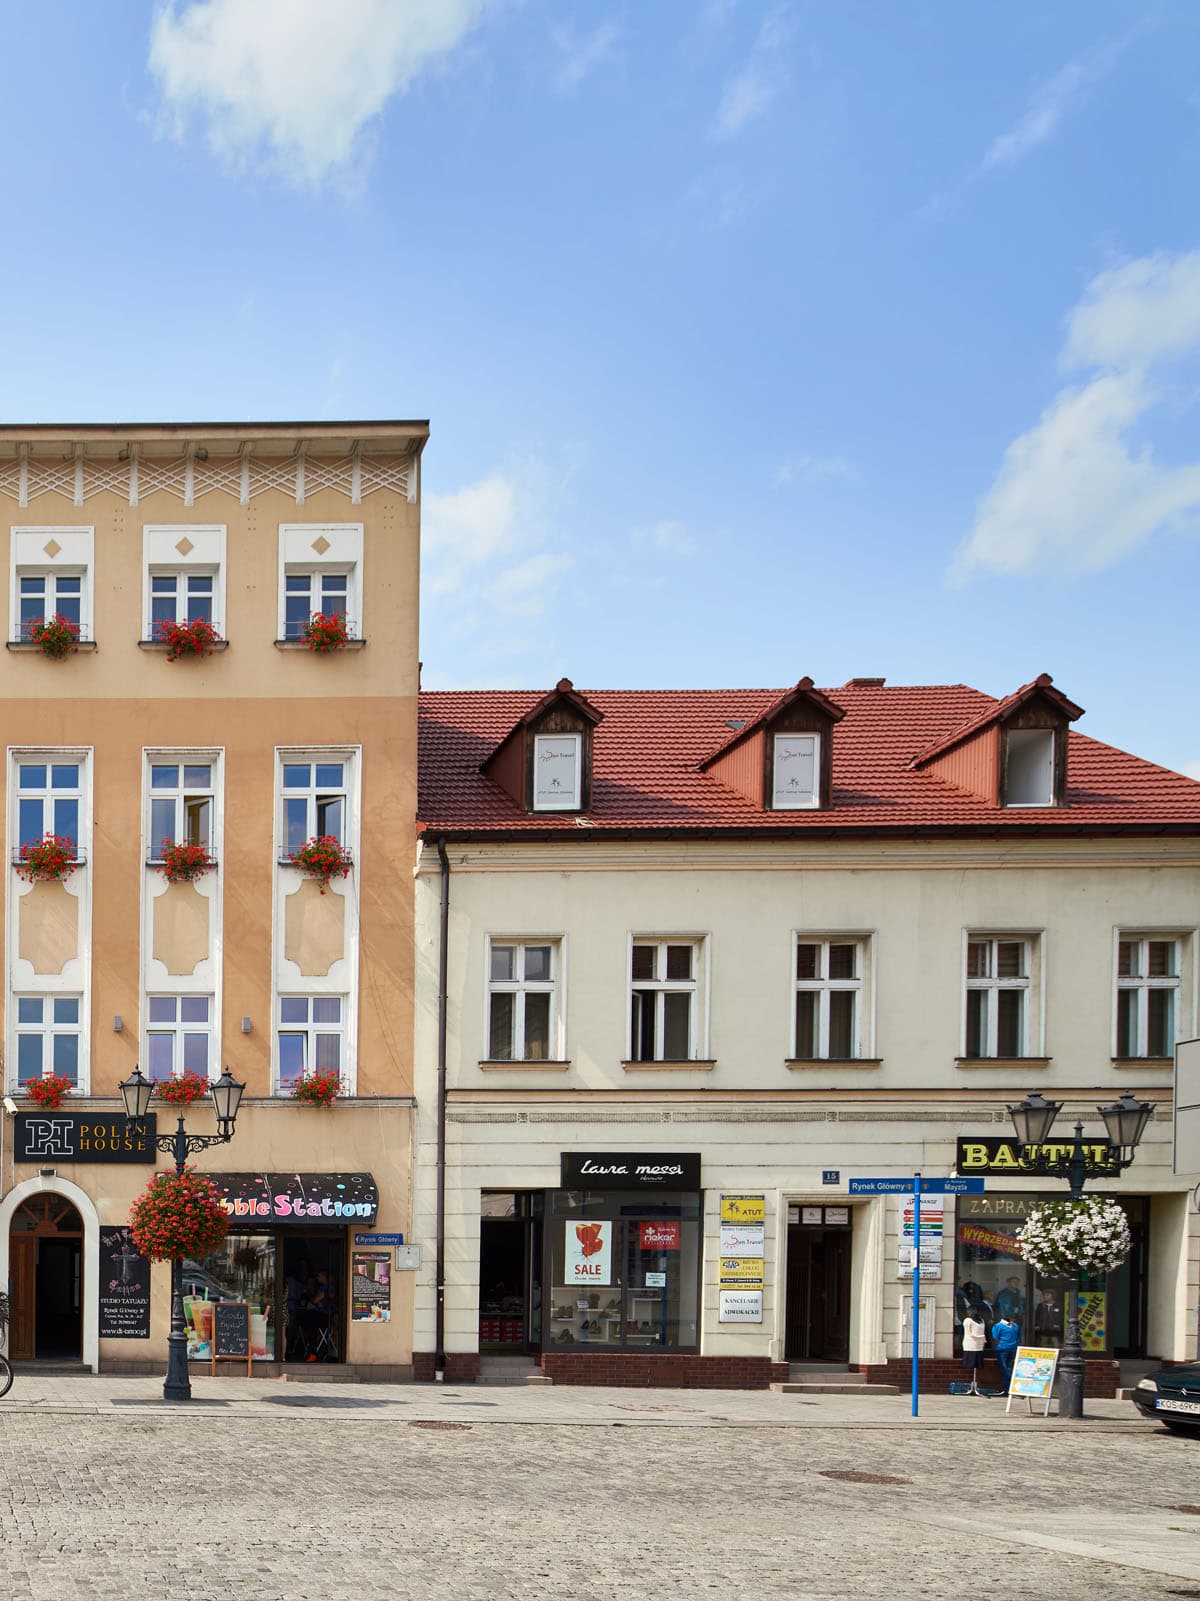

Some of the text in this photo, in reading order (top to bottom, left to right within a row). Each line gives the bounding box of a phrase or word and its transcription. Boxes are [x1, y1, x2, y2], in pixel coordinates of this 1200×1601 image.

[79, 1138, 147, 1151] HOUSE
[580, 1160, 684, 1175] Laura messi
[825, 1172, 837, 1180] 15
[852, 1181, 906, 1192] Rynek Główny
[218, 1195, 372, 1218] bble Station
[970, 1200, 1047, 1214] ZAPRASZ
[644, 1233, 675, 1241] rieker
[963, 1226, 1018, 1248] WYPRZEDA
[574, 1264, 602, 1275] SALE
[1160, 1399, 1177, 1409] KOS
